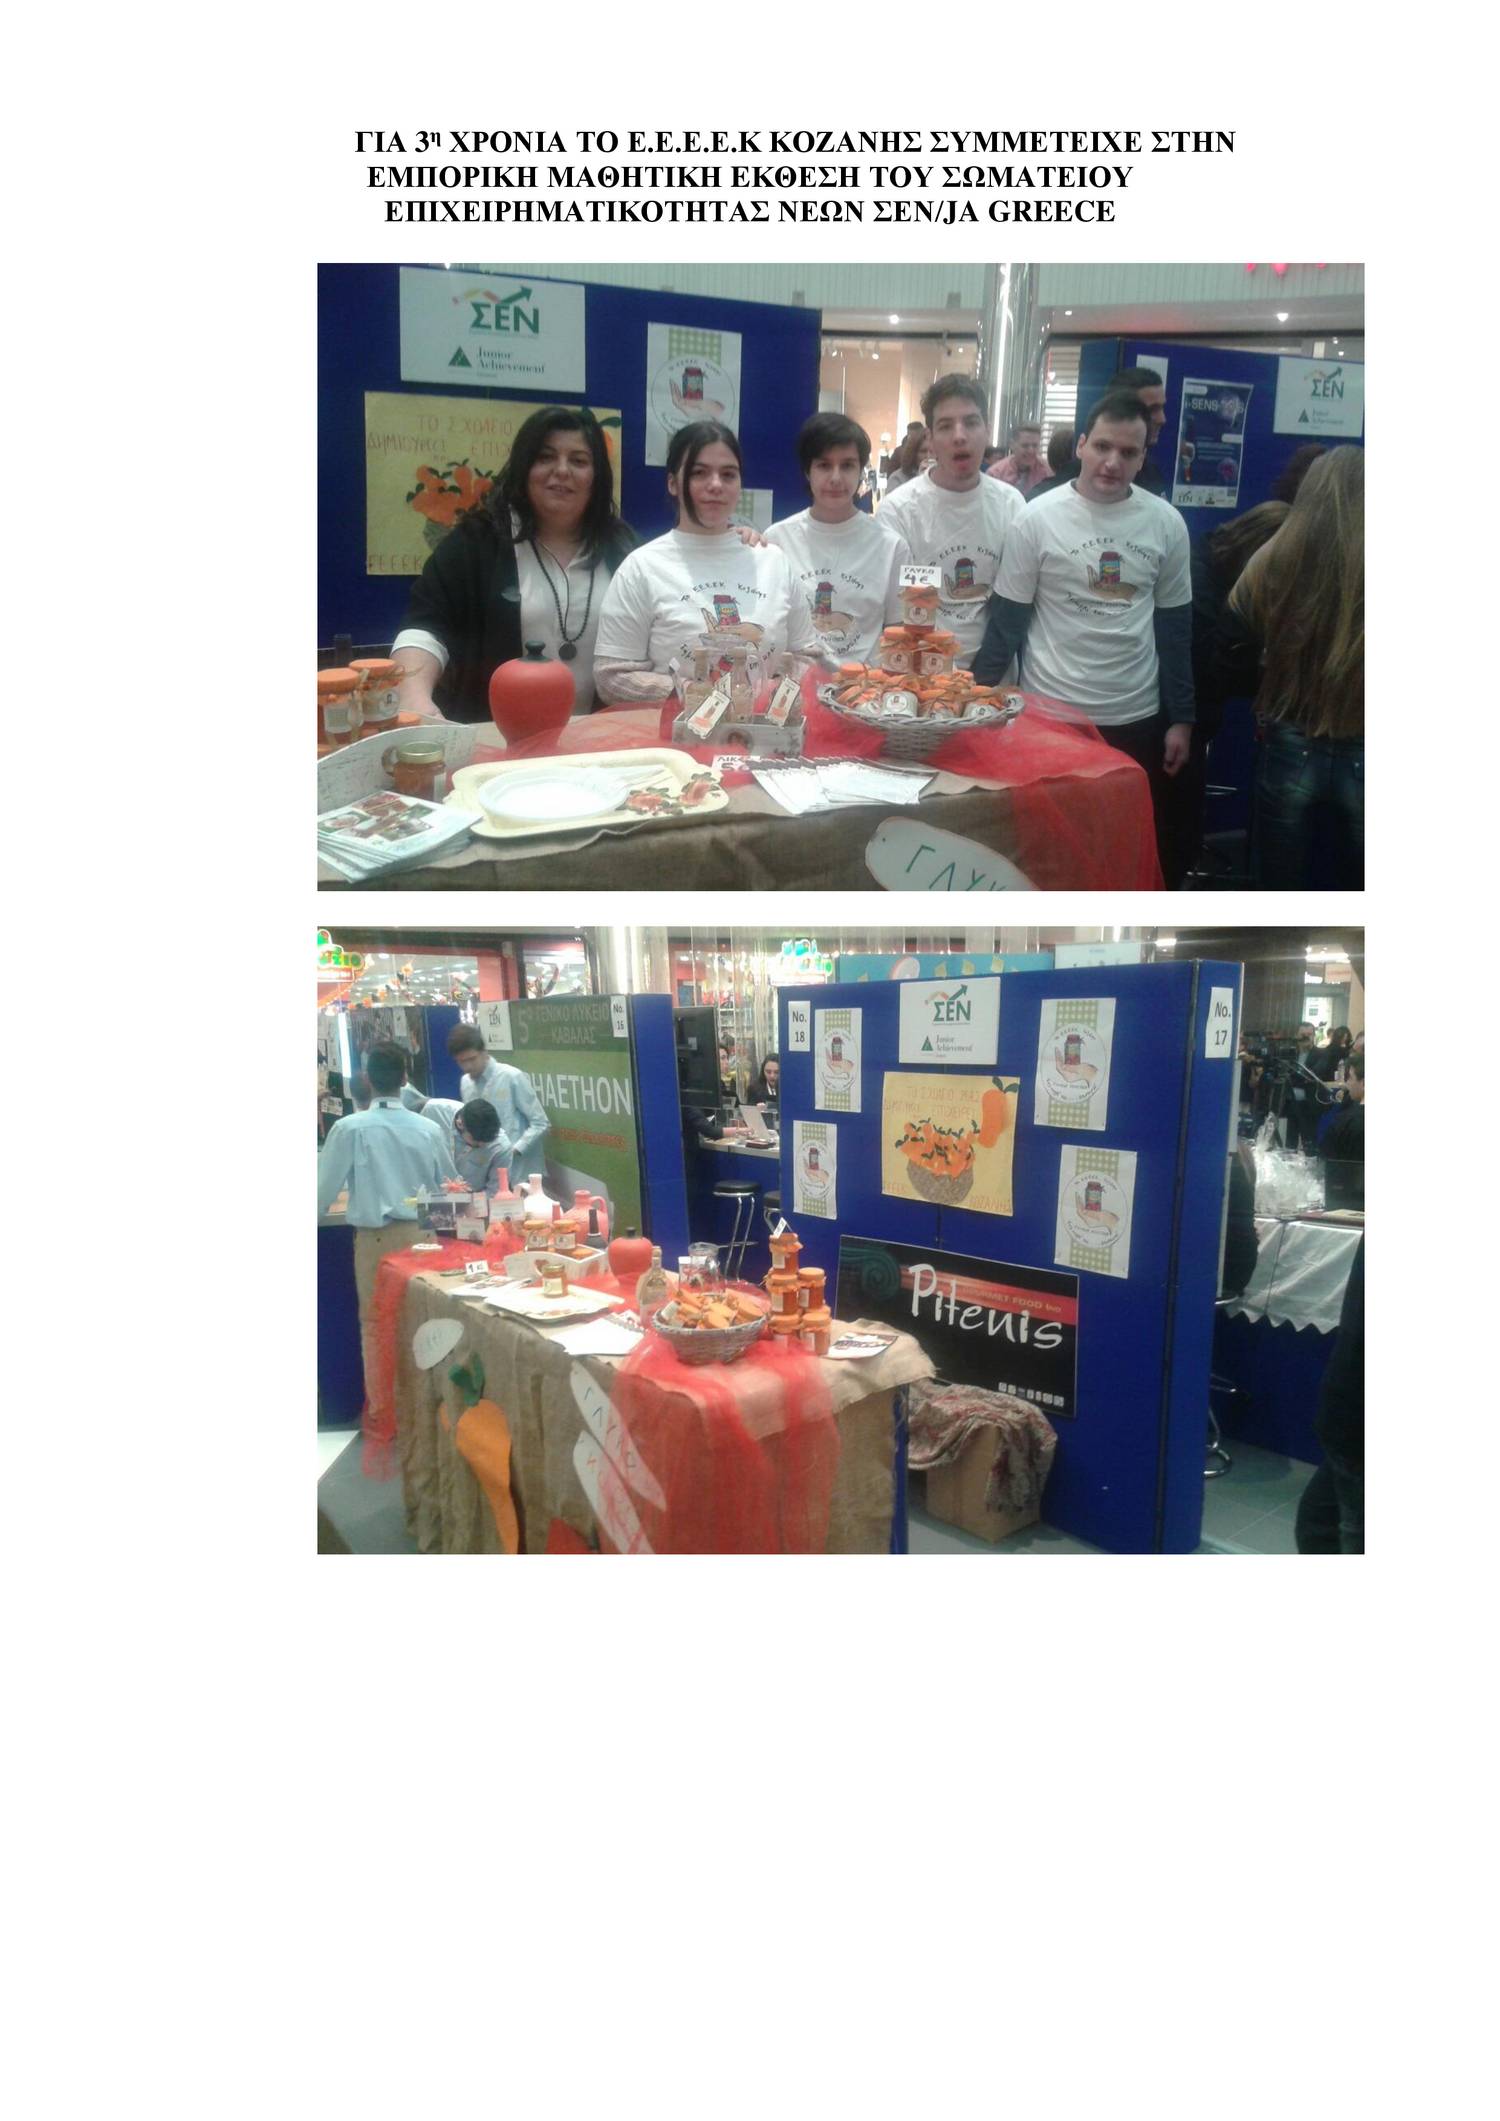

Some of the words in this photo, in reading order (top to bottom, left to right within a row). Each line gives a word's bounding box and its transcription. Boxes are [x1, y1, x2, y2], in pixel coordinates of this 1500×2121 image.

[355, 131, 407, 153] ΓΙΑ
[450, 131, 568, 153] ΧΡΟΝΙΑ
[577, 131, 619, 153] ΤΟ
[628, 131, 763, 153] Ε.Ε.Ε.Ε.Κ
[769, 131, 922, 153] ΚΟΖΑΝΗΣ
[930, 131, 1142, 153] ΣΥΜΜΕΤΕΙΧΕ
[1152, 131, 1236, 153] ΣΤΗΝ
[367, 166, 539, 188] ΕΜΠΟΡΙΚΗ
[547, 166, 722, 188] ΜΑΘΗΤΙΚΗ
[731, 166, 860, 188] ΕΚΘΕΣΗ
[870, 166, 934, 188] ΤΟΥ
[942, 166, 1133, 188] ΣΩΜΑΤΕΙΟΥ
[385, 201, 769, 223] ΕΠΙΧΕΙΡΗΜΑΤΙΚΟΤΗΤΑΣ
[778, 201, 865, 223] ΝΕΩΝ
[873, 201, 979, 223] ΣΕΝ/JA
[989, 200, 1116, 223] GREECE
[470, 302, 541, 335] ΣΕΝ
[476, 346, 512, 360] Junior
[477, 358, 546, 375] Achievement
[1311, 378, 1344, 399] ΣΕΝ
[792, 1010, 807, 1023] No.
[933, 1000, 972, 1022] ΣΕΝ
[1214, 1001, 1231, 1018] No.
[616, 1019, 625, 1031] 16
[794, 1031, 806, 1044] 18
[1214, 1029, 1228, 1046] 17
[908, 1263, 1063, 1349] Pitenis
